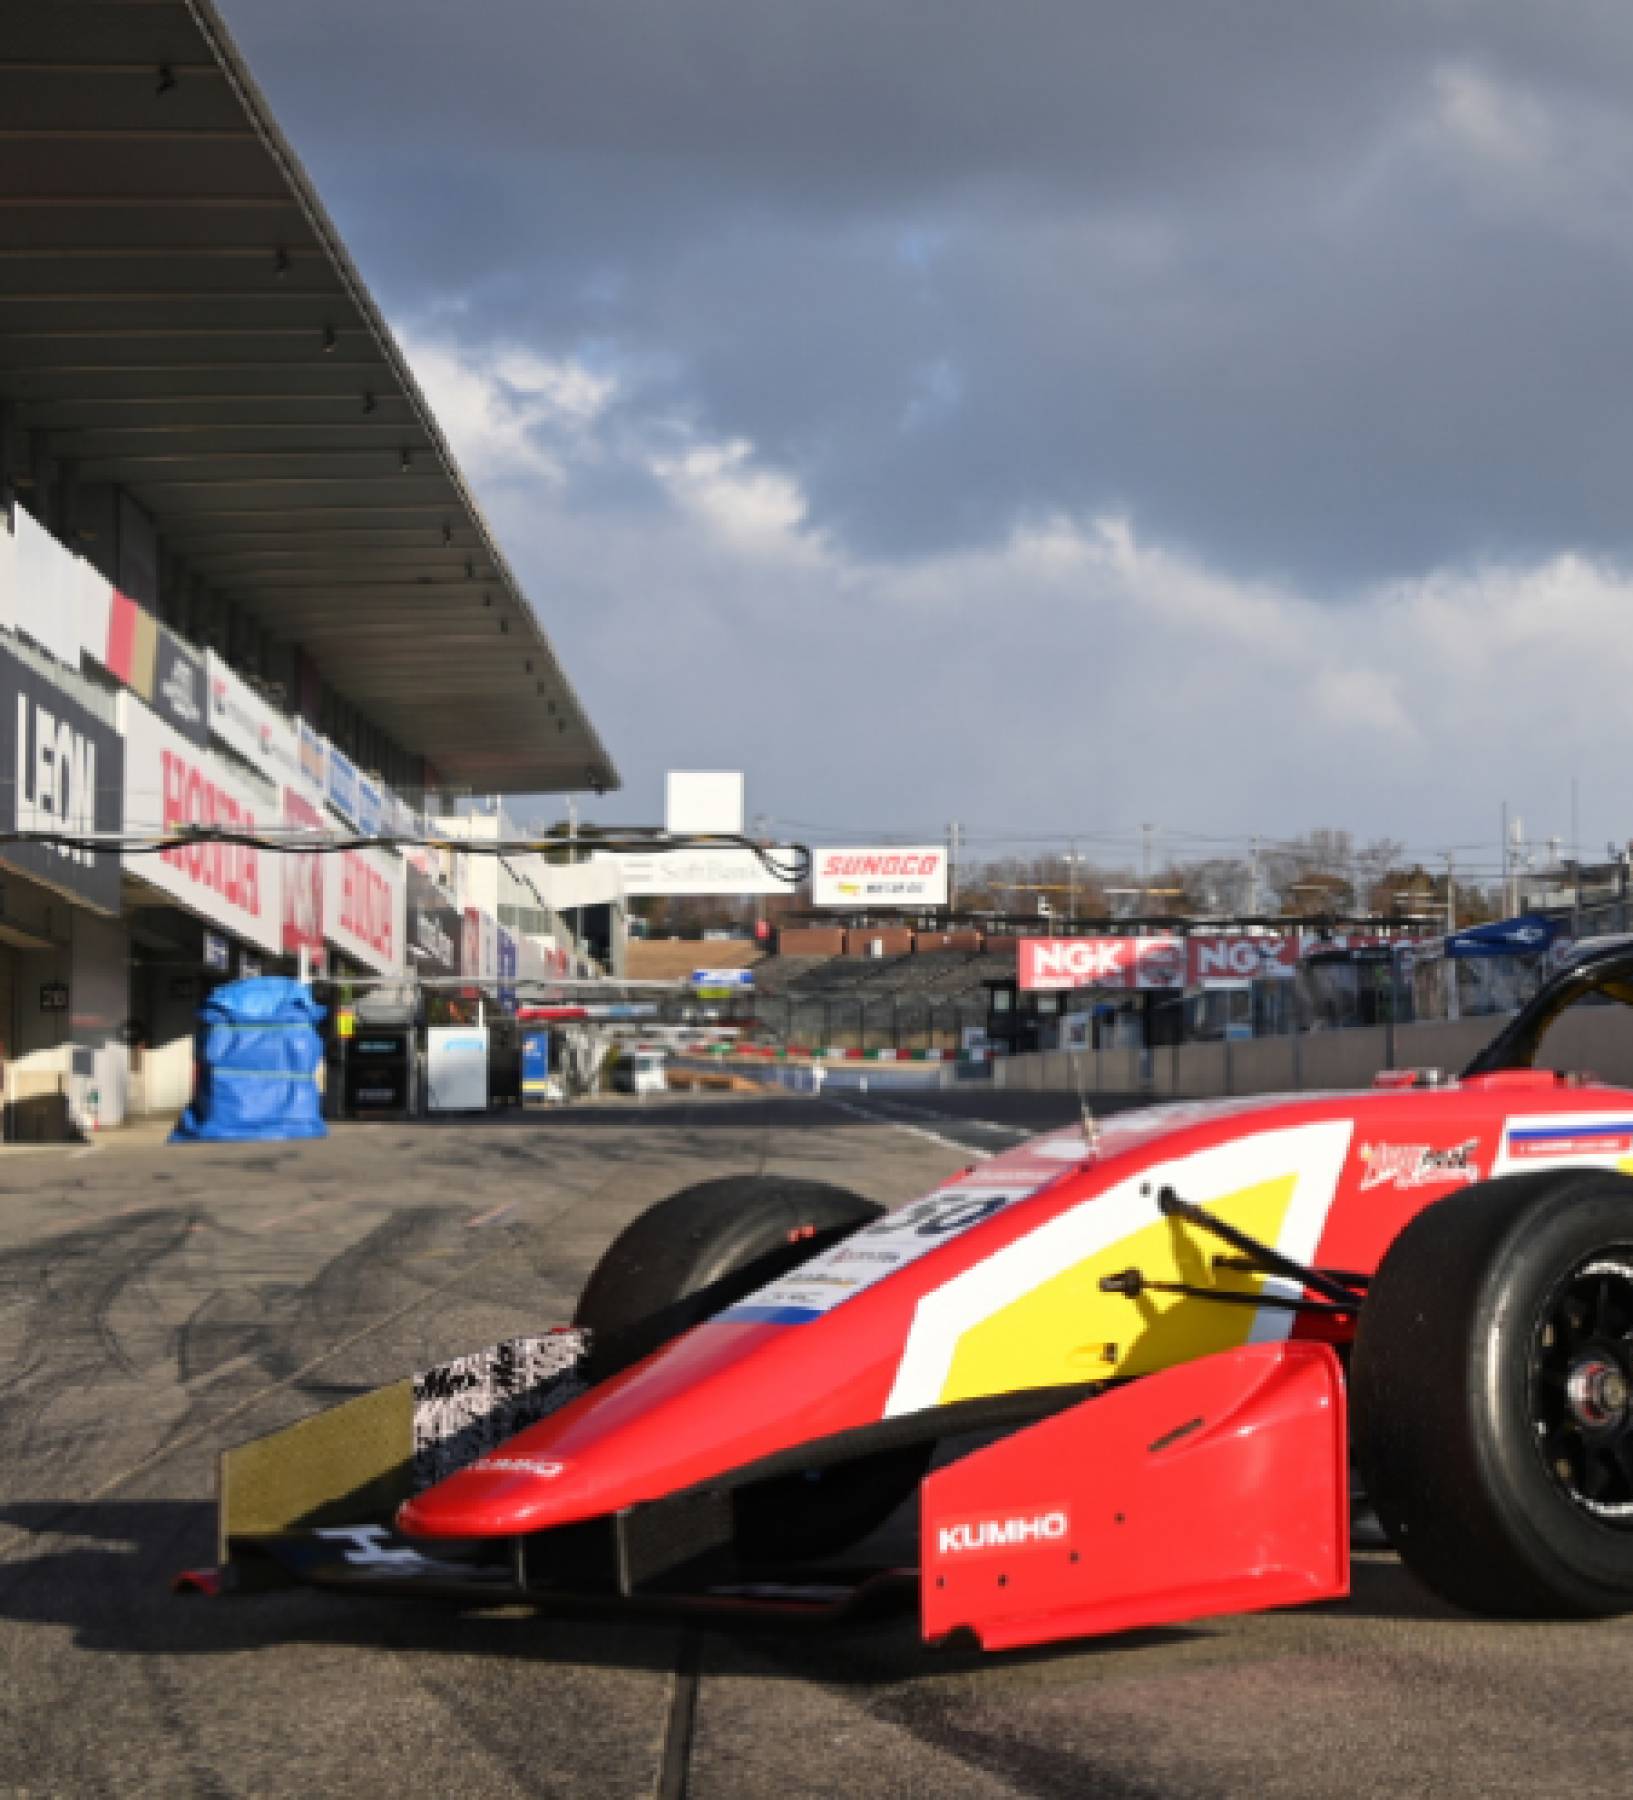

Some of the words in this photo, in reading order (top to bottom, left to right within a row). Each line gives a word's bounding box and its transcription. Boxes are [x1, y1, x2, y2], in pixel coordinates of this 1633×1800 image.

[14, 690, 95, 868] LEON
[161, 748, 260, 917] HONDA
[821, 855, 940, 876] SUNOCO
[1031, 942, 1126, 974] NGK
[937, 1511, 1067, 1554] KUMHO
